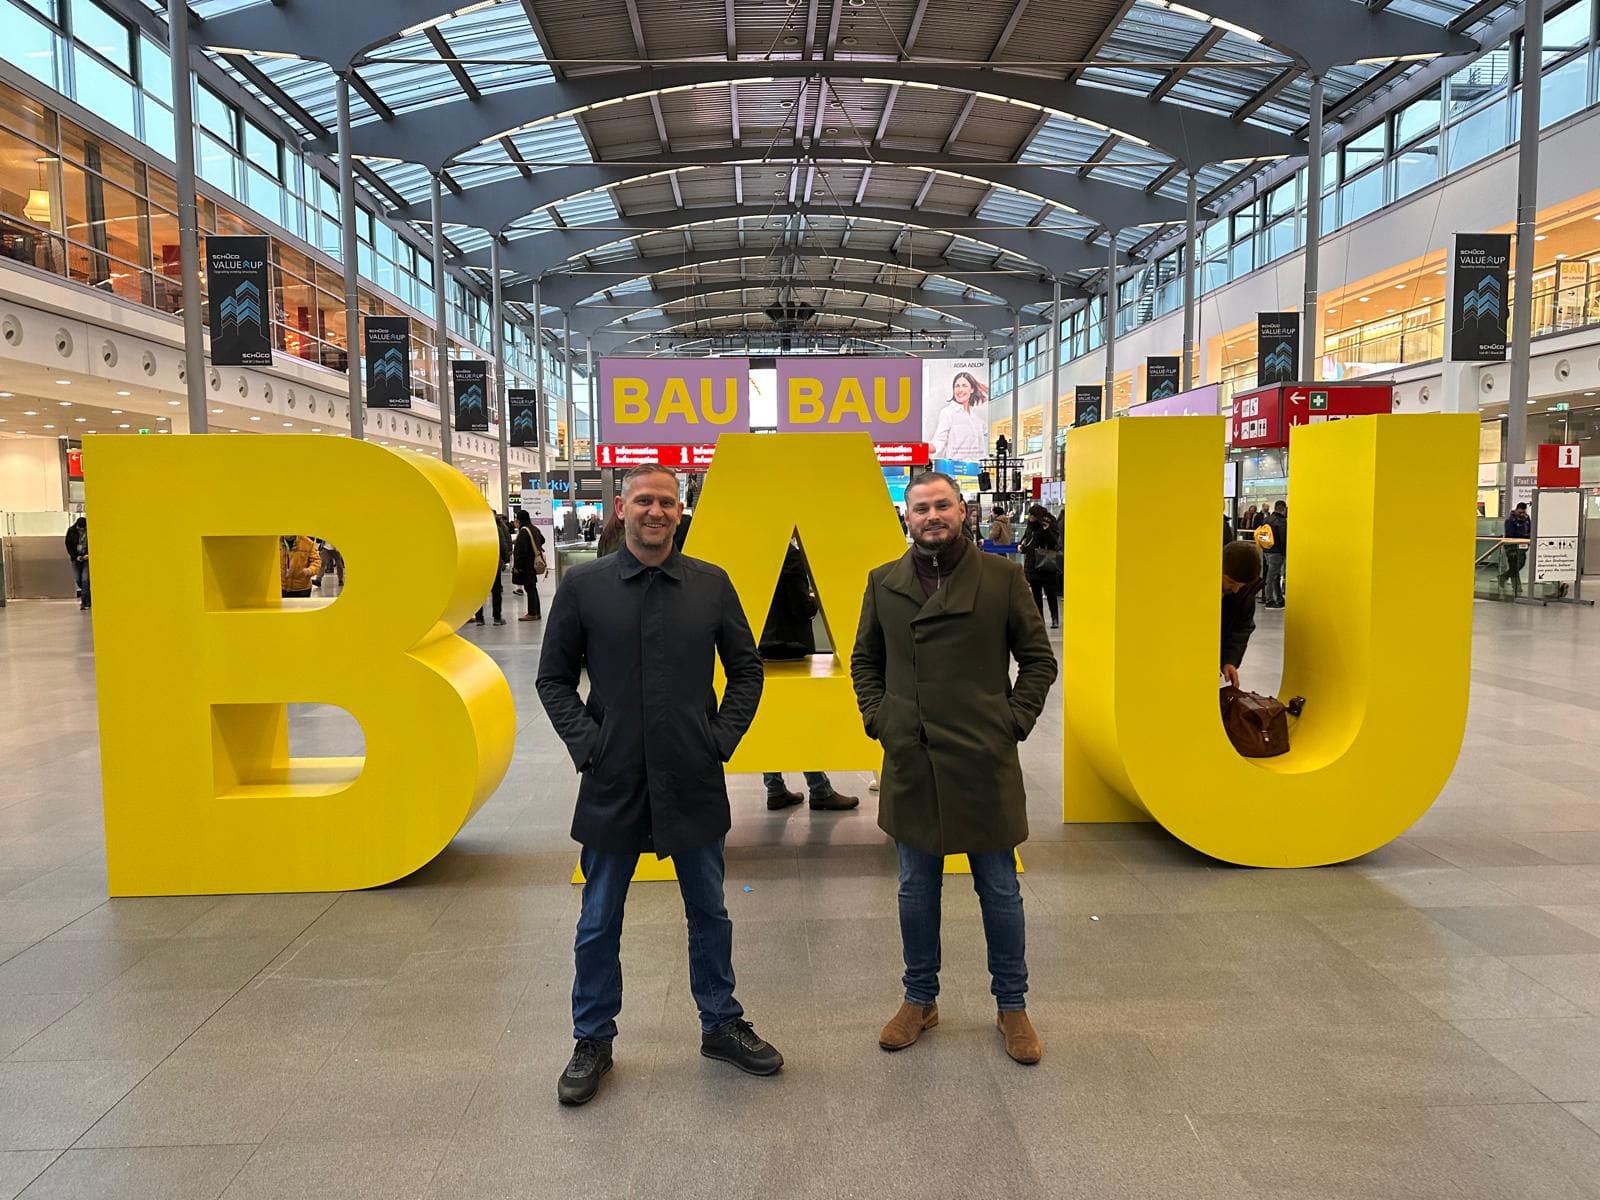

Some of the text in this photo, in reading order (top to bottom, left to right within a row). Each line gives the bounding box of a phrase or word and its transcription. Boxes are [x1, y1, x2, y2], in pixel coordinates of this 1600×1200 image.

[212, 260, 264, 269] VALUE UP
[1460, 256, 1506, 264] VALUE UP
[1561, 264, 1585, 273] BAU
[612, 377, 738, 425] BAU
[788, 376, 911, 424] BAU
[615, 446, 659, 455] Information
[693, 446, 716, 455] Inform
[874, 445, 912, 454] formation
[615, 455, 659, 464] Information
[877, 454, 912, 462] formation
[83, 413, 1480, 898] BAU
